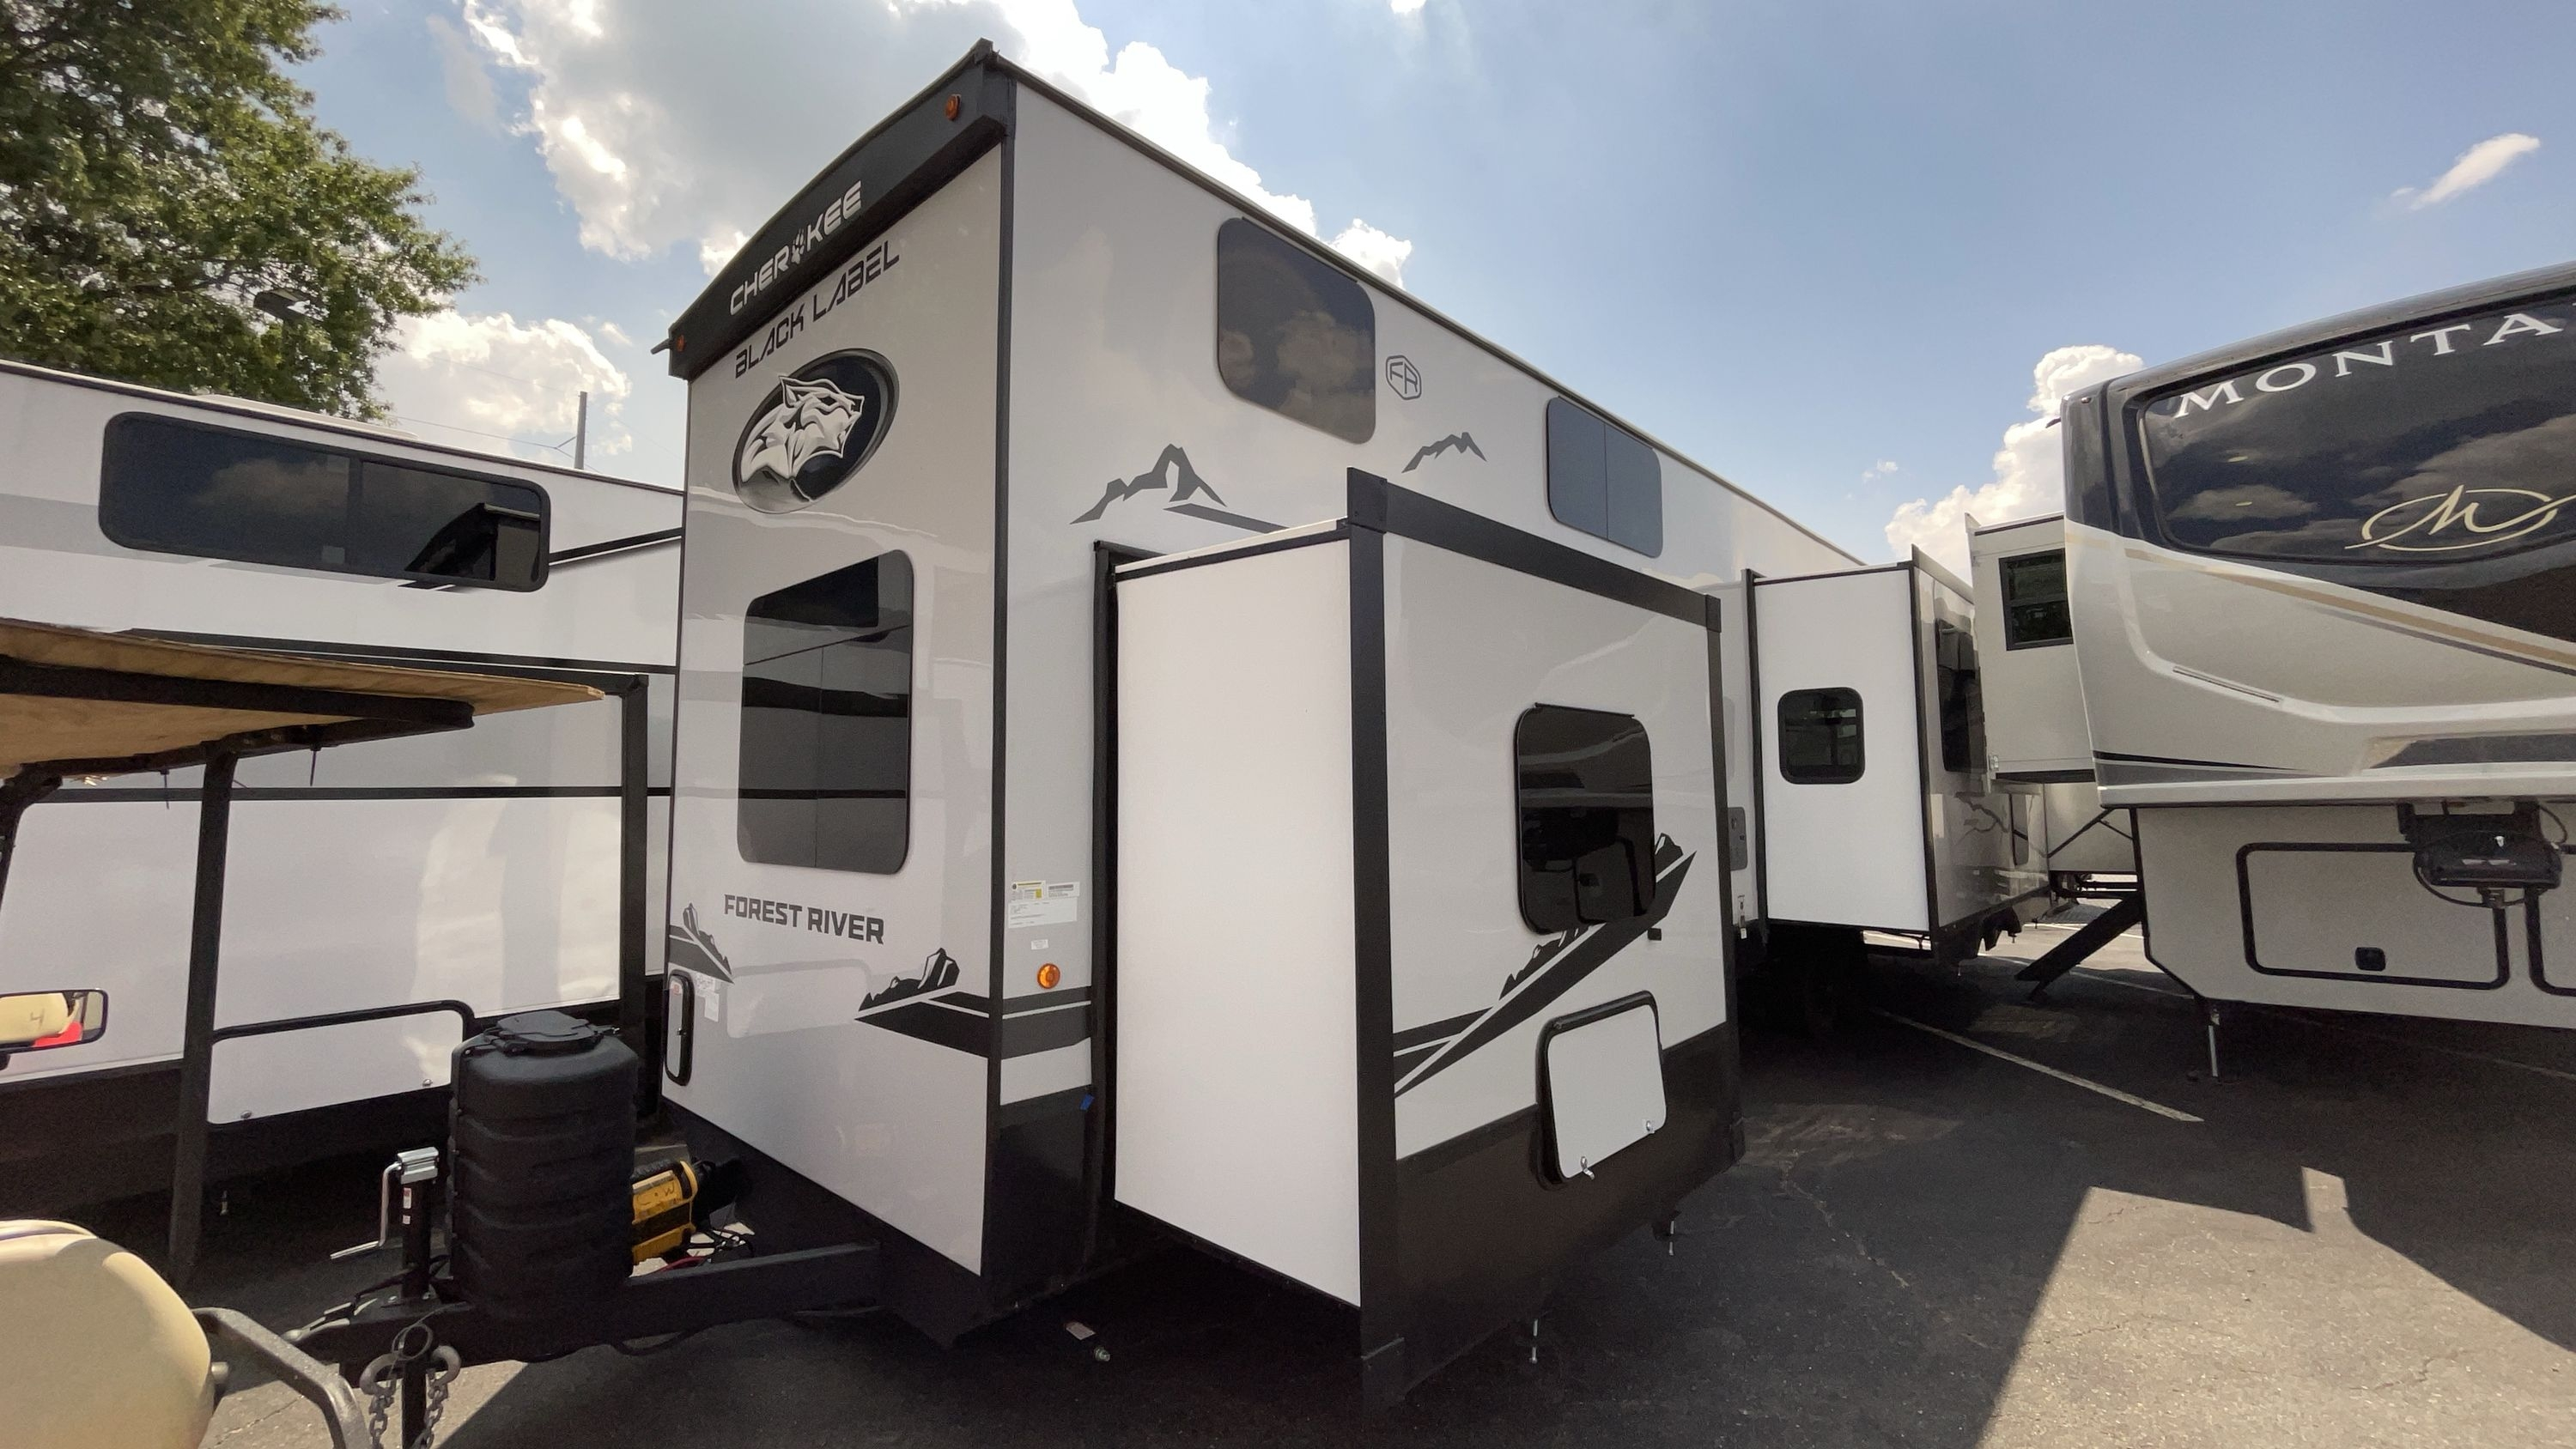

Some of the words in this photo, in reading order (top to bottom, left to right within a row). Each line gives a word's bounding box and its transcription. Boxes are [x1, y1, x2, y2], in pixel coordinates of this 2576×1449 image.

[735, 303, 805, 379] BLACK
[812, 240, 900, 322] LABEL
[2173, 302, 2576, 418] MONTA
[724, 894, 803, 928] FOREST
[807, 906, 884, 944] RIVER
